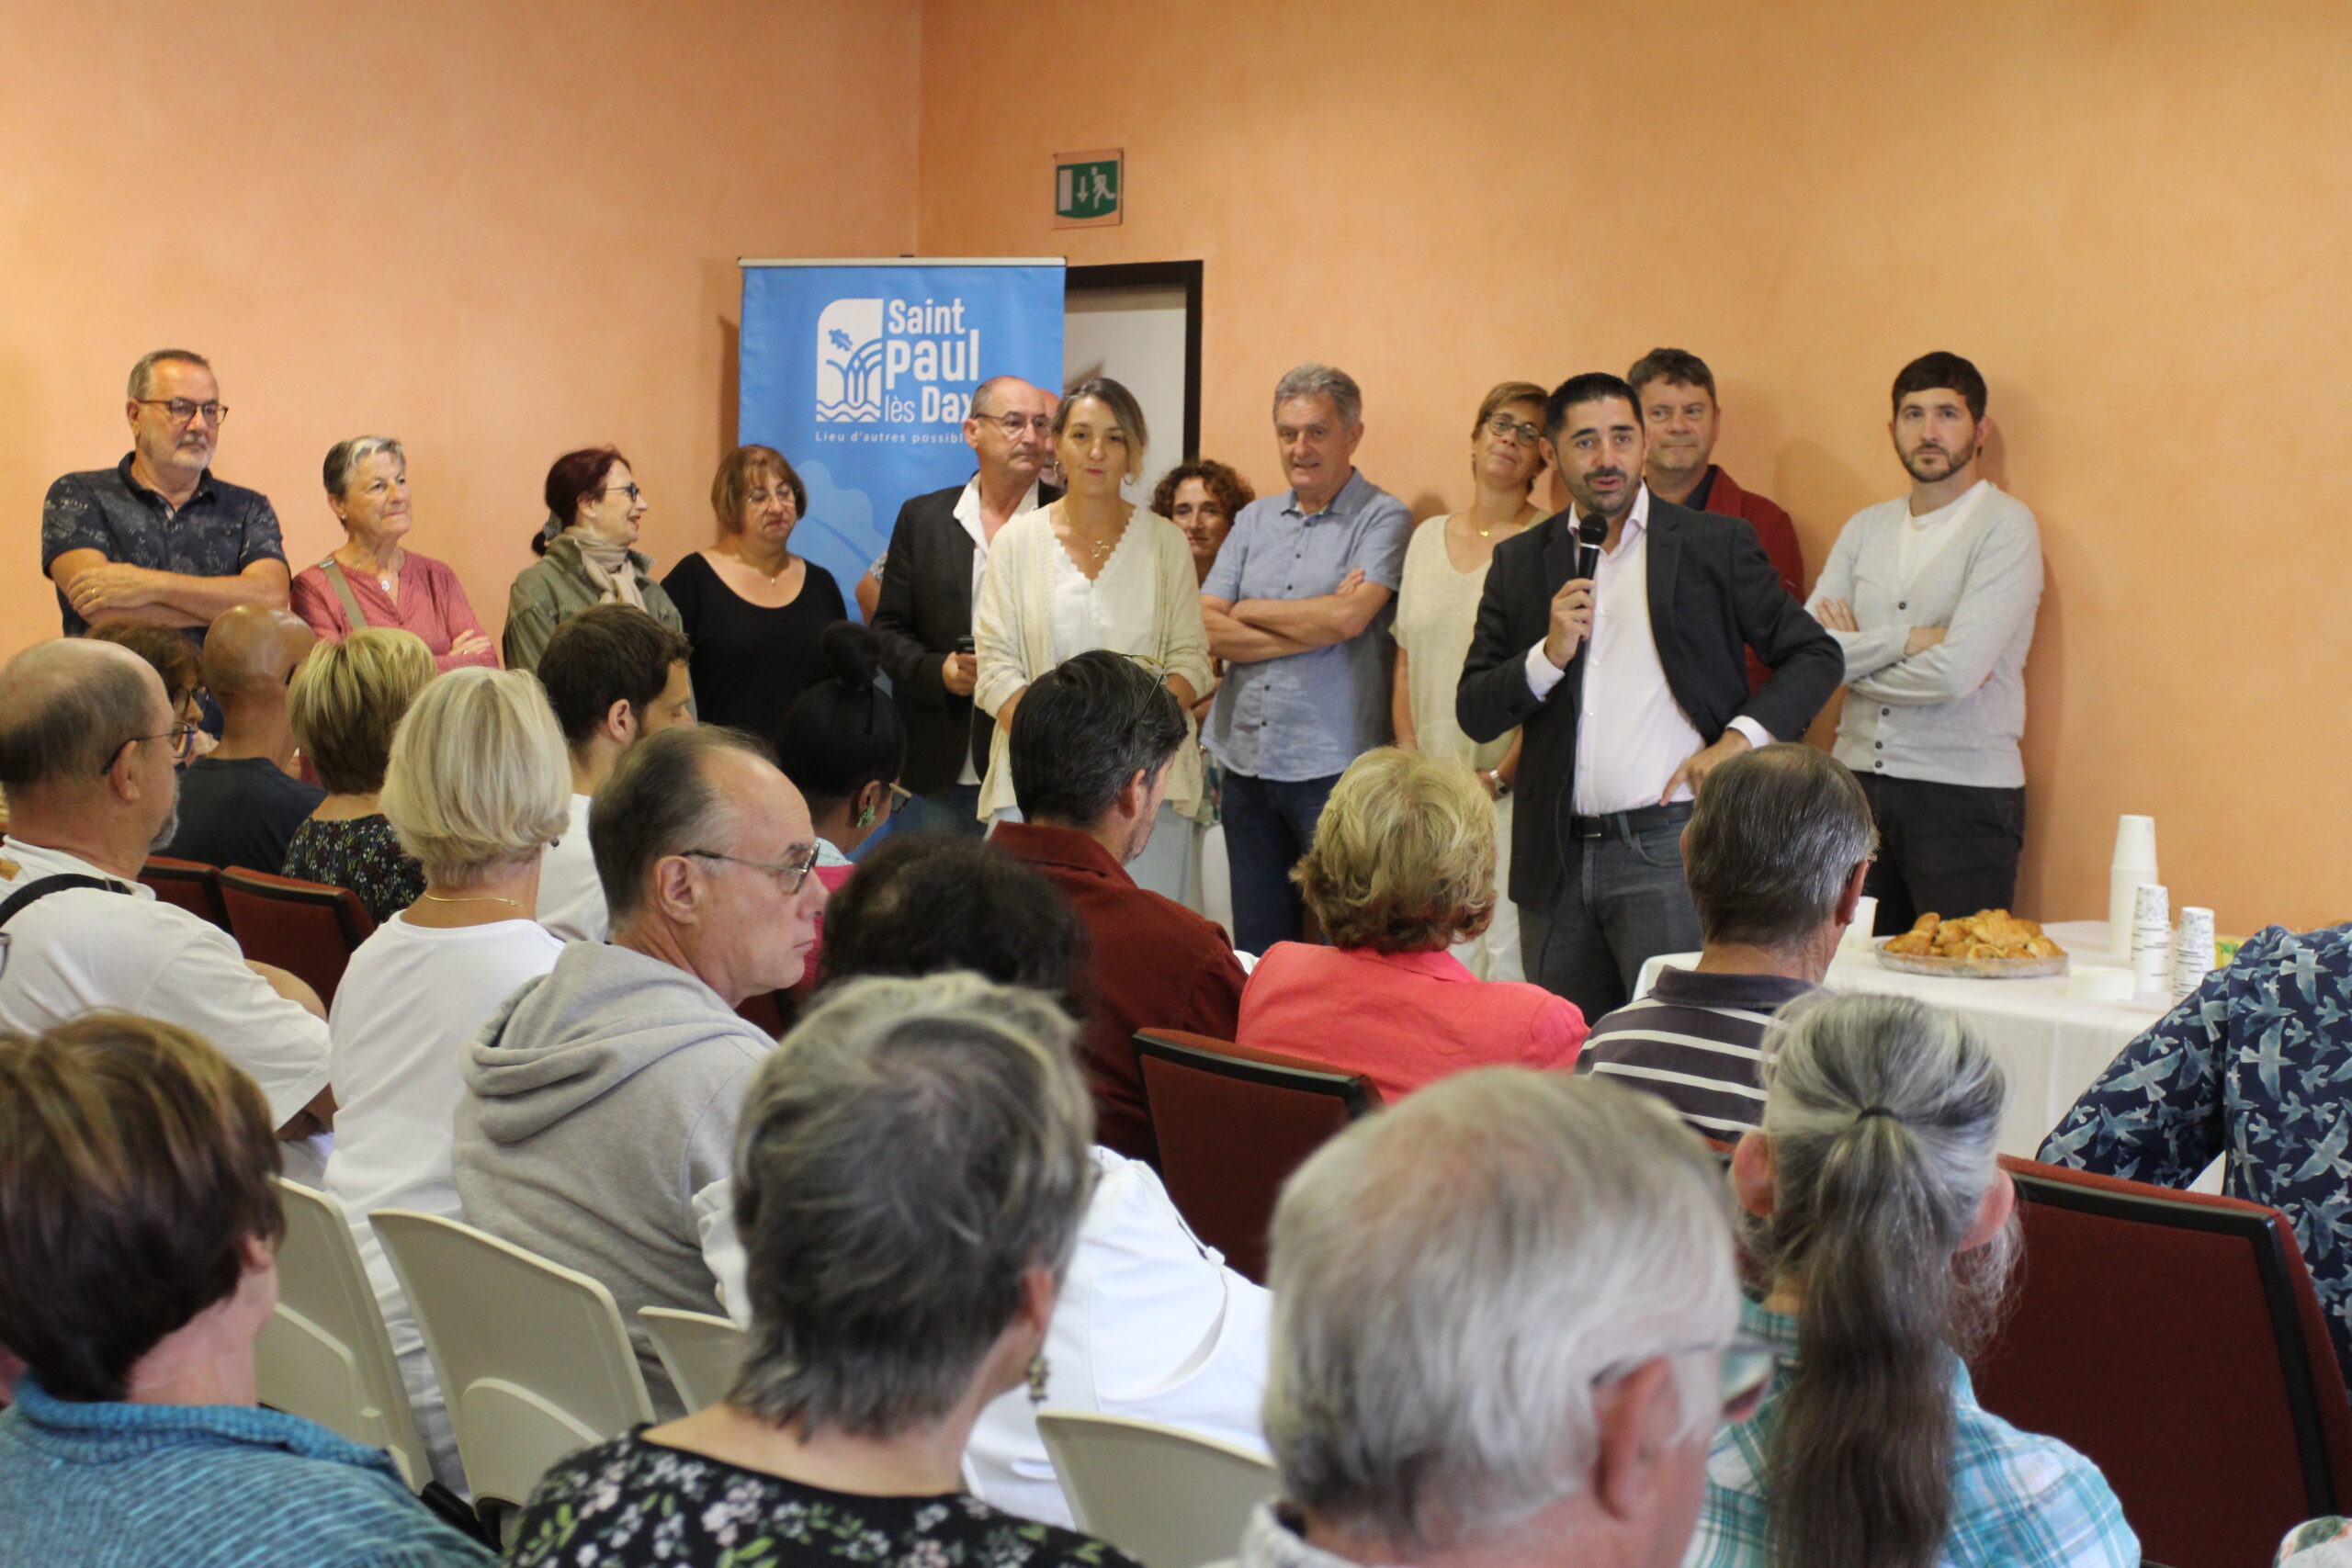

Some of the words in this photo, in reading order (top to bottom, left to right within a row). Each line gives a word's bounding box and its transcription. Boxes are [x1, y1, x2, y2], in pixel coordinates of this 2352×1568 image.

[888, 298, 966, 334] Saint
[885, 395, 916, 423] lès
[815, 431, 845, 442] Lieu
[851, 431, 907, 443] d'autres
[911, 432, 964, 444] possibl
